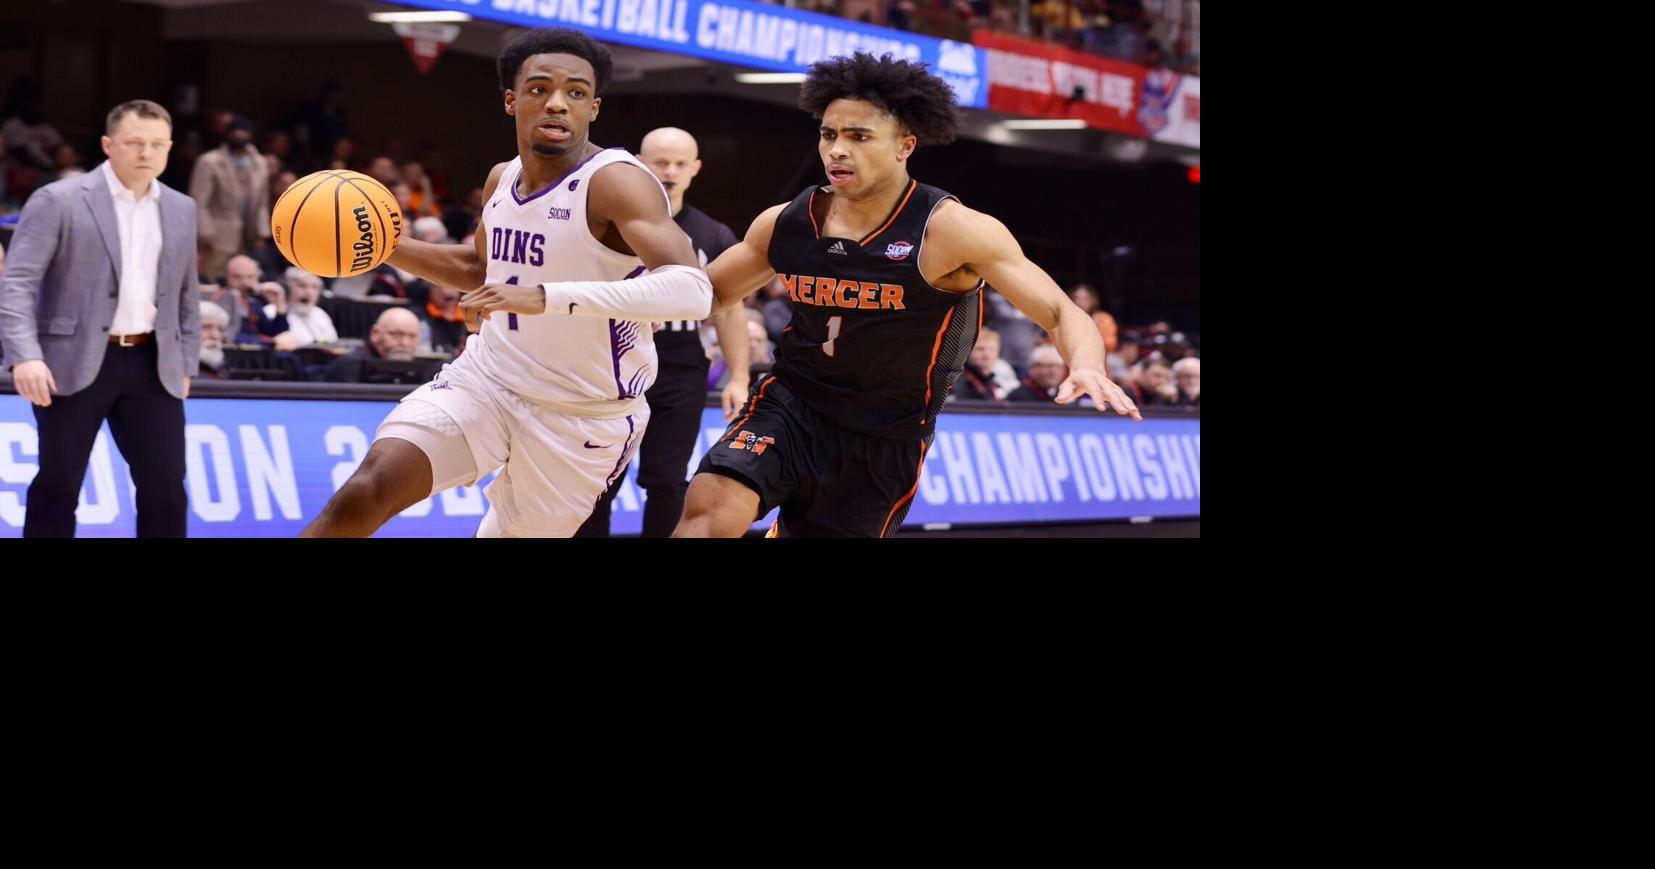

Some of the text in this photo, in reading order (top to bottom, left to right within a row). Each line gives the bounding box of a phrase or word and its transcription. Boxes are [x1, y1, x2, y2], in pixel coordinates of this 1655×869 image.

[493, 0, 689, 44] ETBALL
[547, 207, 571, 221] SOCON
[350, 205, 374, 272] Wilson
[492, 227, 545, 267] DINS
[776, 273, 906, 310] MERCER
[822, 316, 842, 357] 1
[0, 422, 303, 527] SOON
[921, 432, 1200, 504] CHAMPIONSHI
